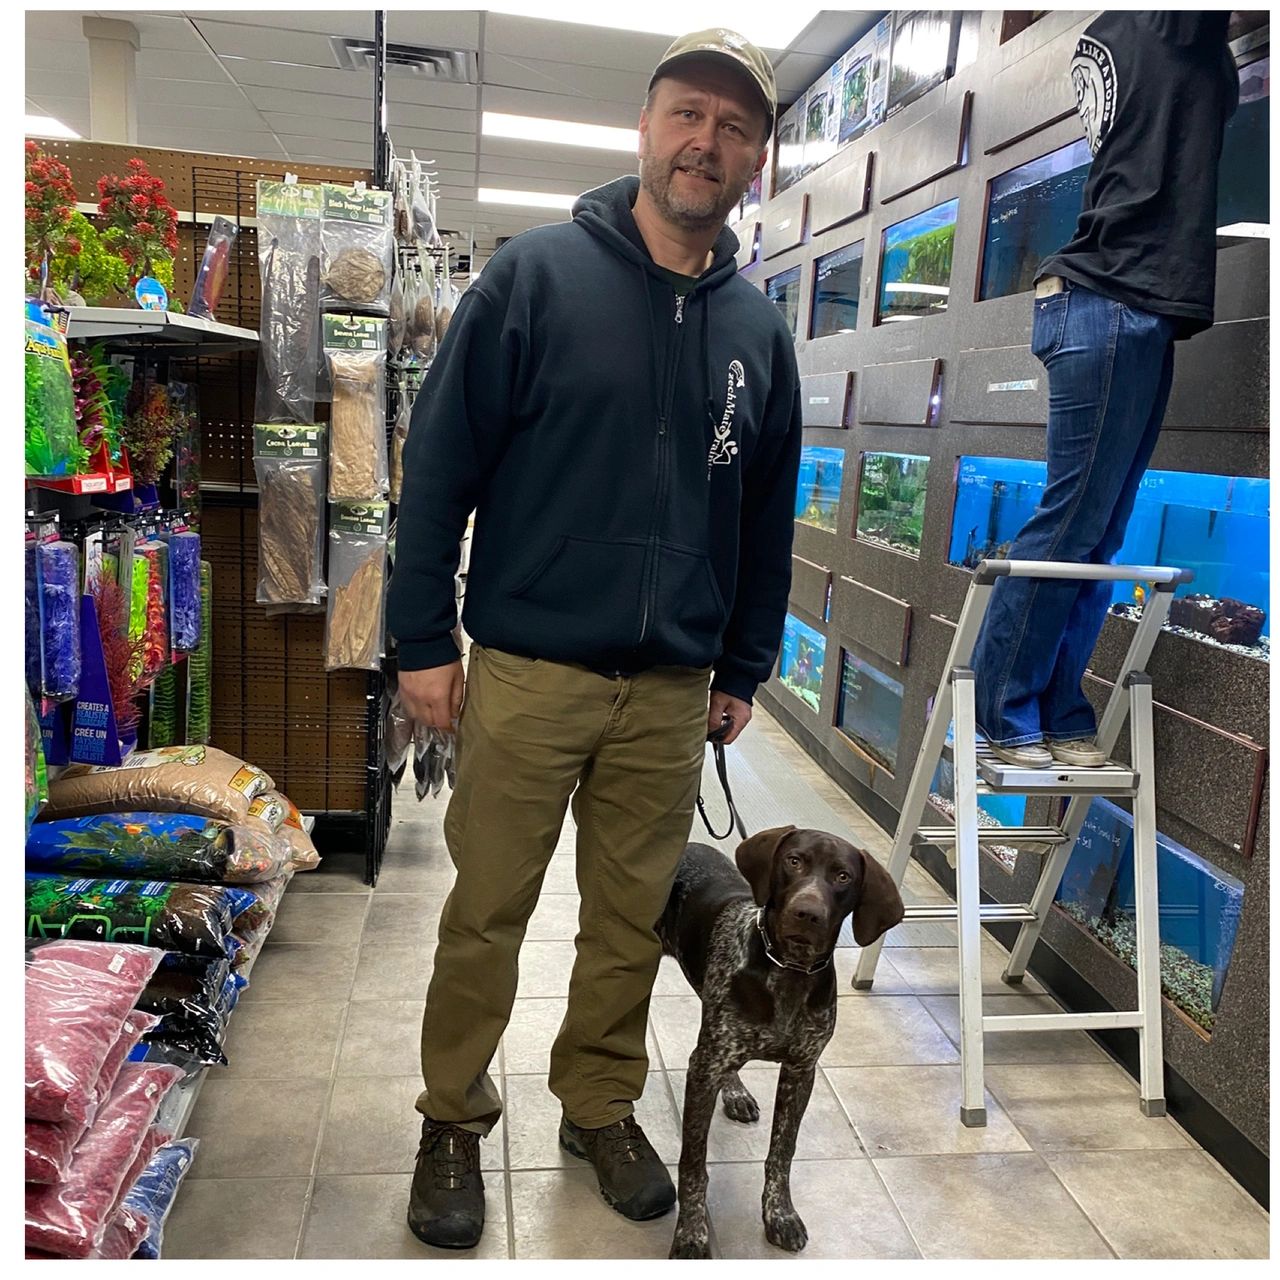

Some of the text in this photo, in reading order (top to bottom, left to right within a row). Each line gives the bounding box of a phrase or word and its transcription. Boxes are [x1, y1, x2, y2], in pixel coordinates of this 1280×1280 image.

[1082, 42, 1113, 121] LIKE A BOSS
[77, 701, 109, 712] CREATES A
[75, 727, 107, 739] CRÉE UN
